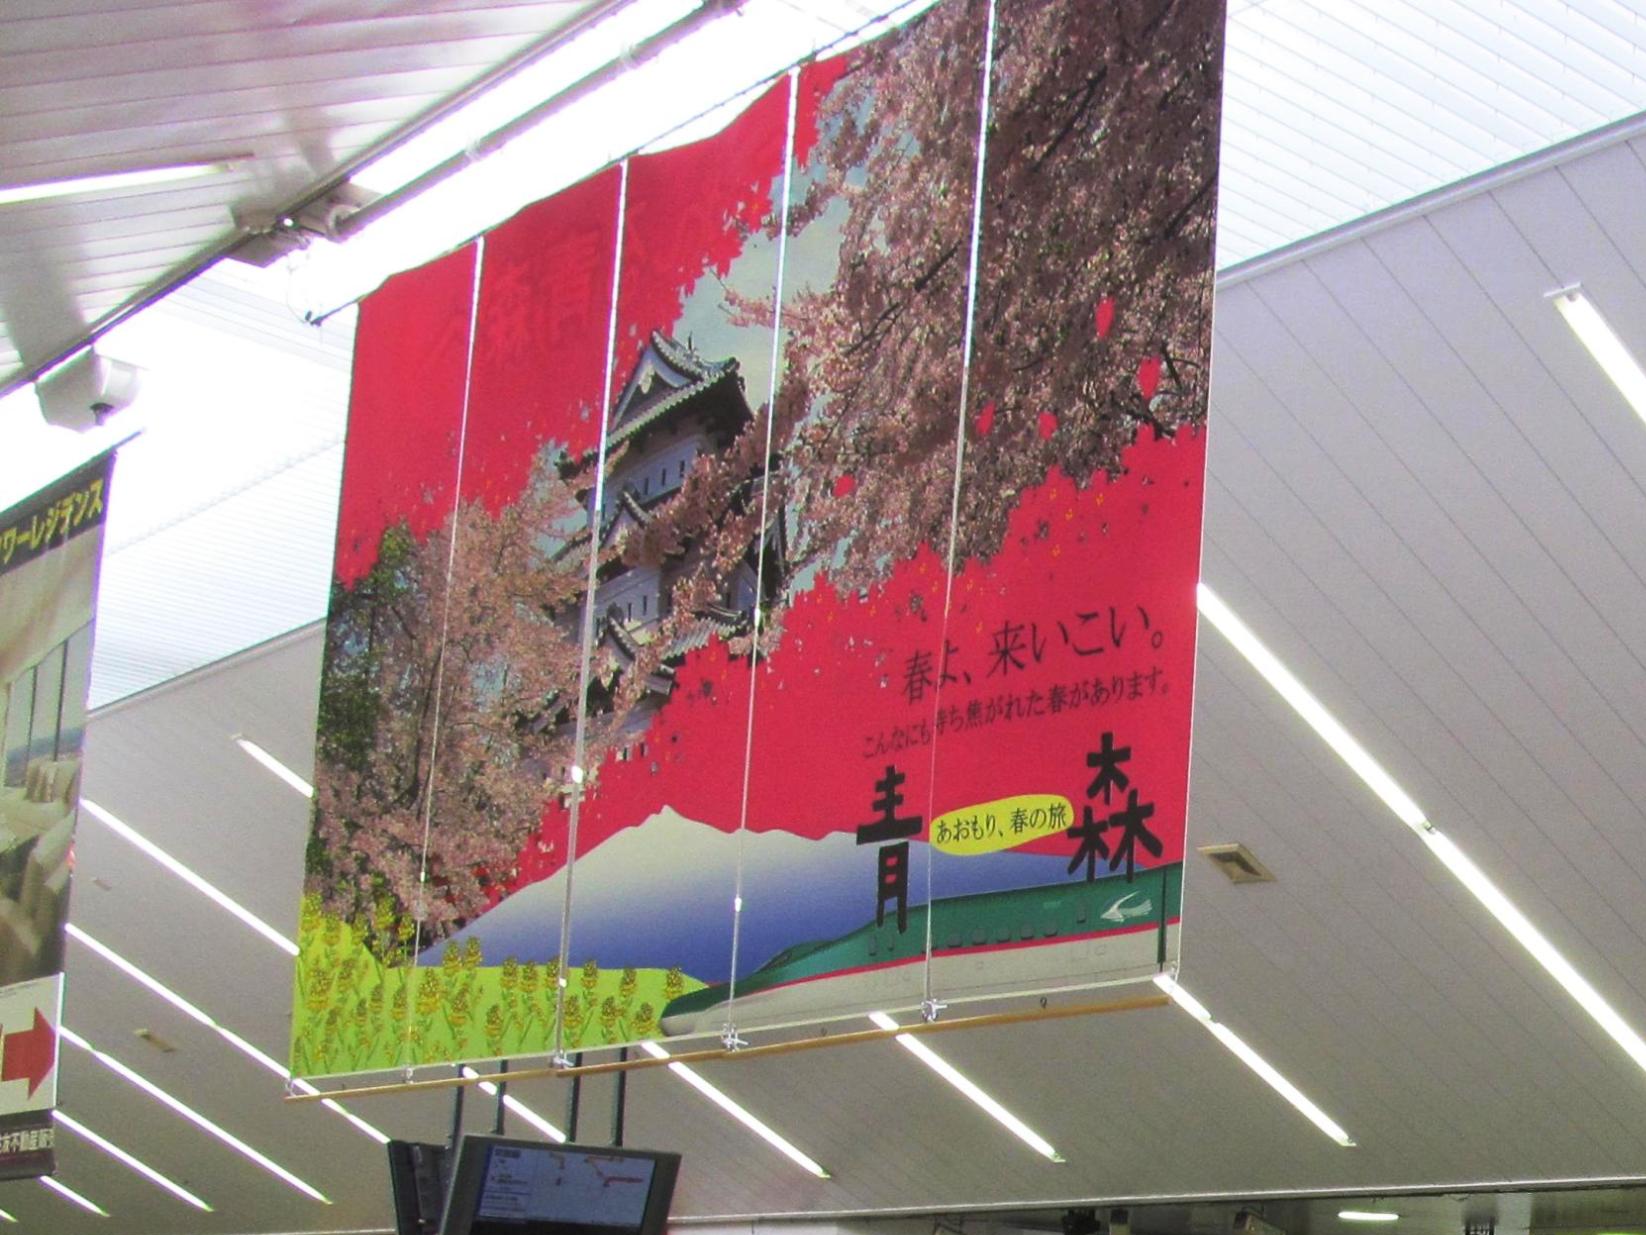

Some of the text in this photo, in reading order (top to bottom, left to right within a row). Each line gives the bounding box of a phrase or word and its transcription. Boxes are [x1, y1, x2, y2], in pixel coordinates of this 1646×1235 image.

[0, 479, 103, 564] ワーレジデンス
[903, 605, 1165, 705] 春よ、来いこい。
[862, 666, 1169, 758] こんなにも待ち焦がれた春があります。
[936, 802, 1067, 845] あおもり、春の旅
